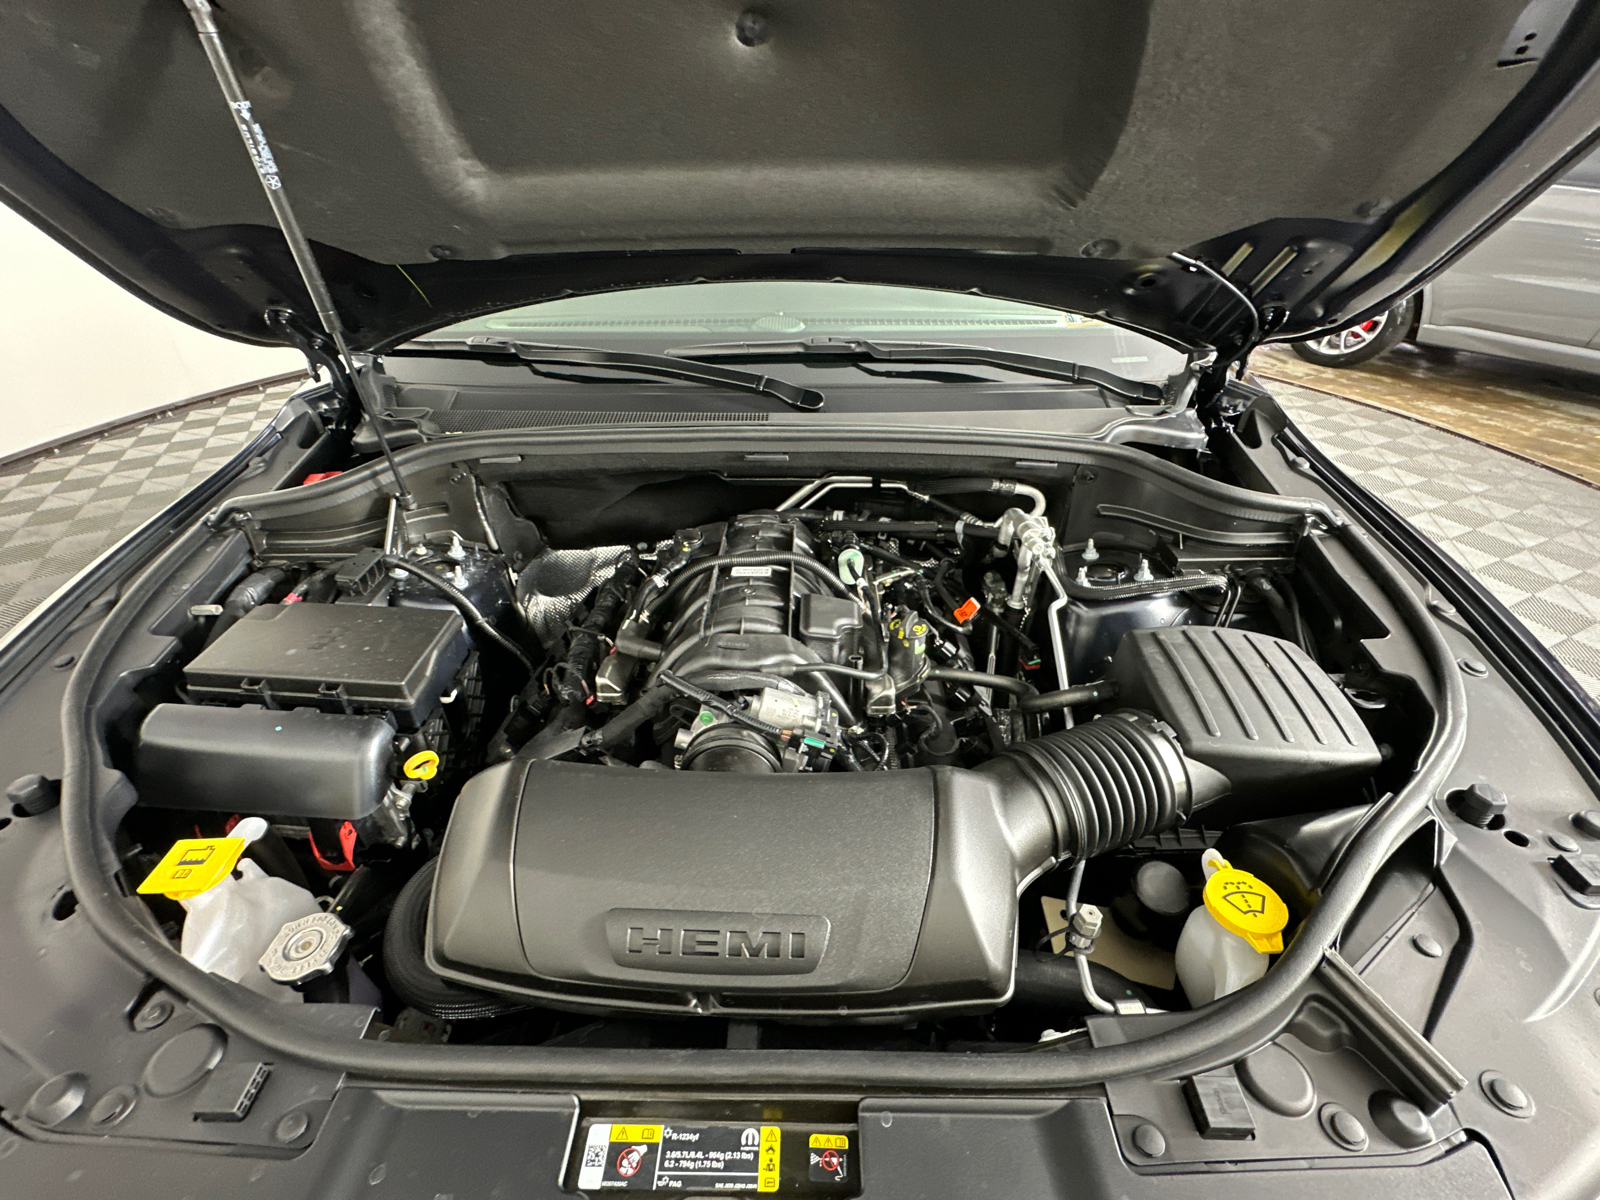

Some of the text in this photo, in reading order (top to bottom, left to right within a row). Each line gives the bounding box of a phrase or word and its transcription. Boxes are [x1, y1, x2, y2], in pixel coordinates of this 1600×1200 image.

[626, 926, 806, 959] HEMI
[671, 1133, 700, 1142] R-1234yf
[725, 1152, 740, 1161] (2.13
[741, 1152, 754, 1161] lbs)
[664, 1160, 675, 1168] 6.2
[695, 1160, 711, 1169] (1.75
[711, 1160, 724, 1170] lbs)
[669, 1180, 682, 1188] PAG
